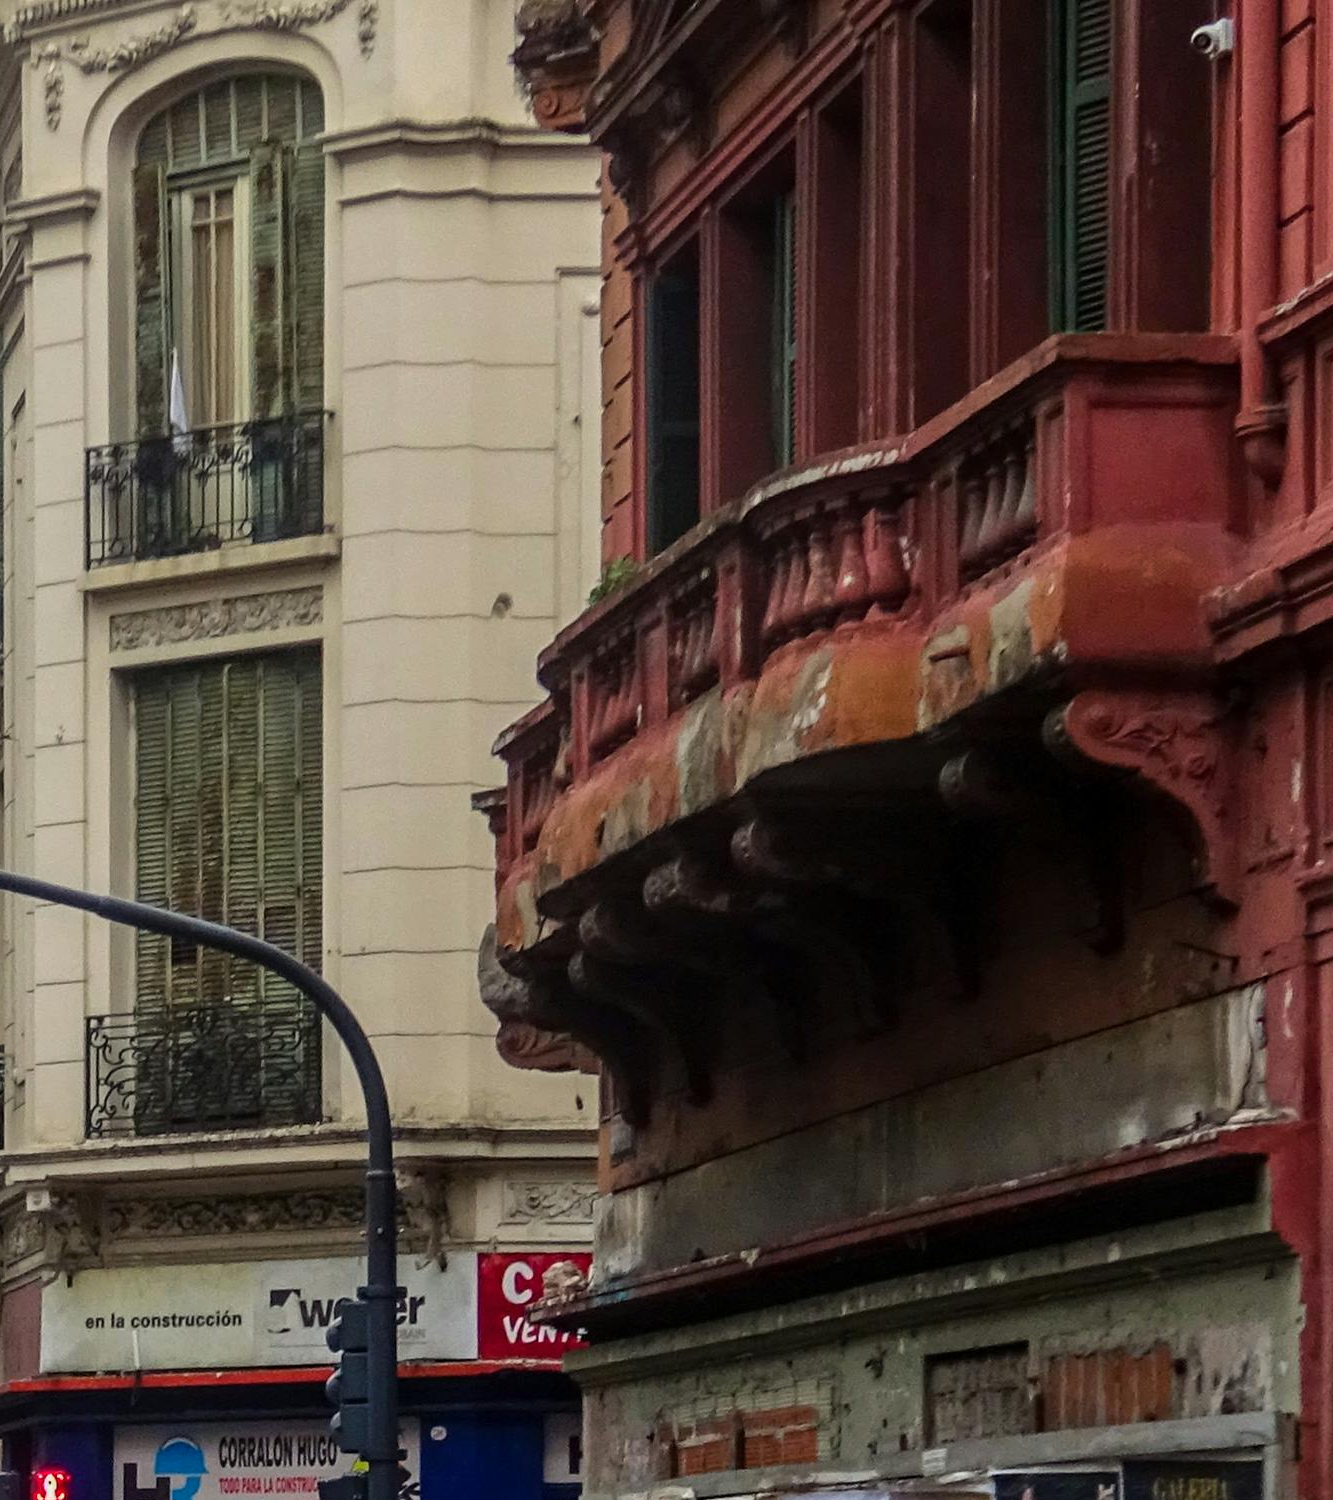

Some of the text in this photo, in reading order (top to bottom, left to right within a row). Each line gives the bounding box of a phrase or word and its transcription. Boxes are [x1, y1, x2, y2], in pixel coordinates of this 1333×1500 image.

[85, 1316, 105, 1329] en
[111, 1313, 125, 1329] la
[131, 1309, 242, 1328] construcción
[297, 1435, 337, 1467] HUGO
[242, 1476, 261, 1493] PARA
[264, 1477, 274, 1493] LA
